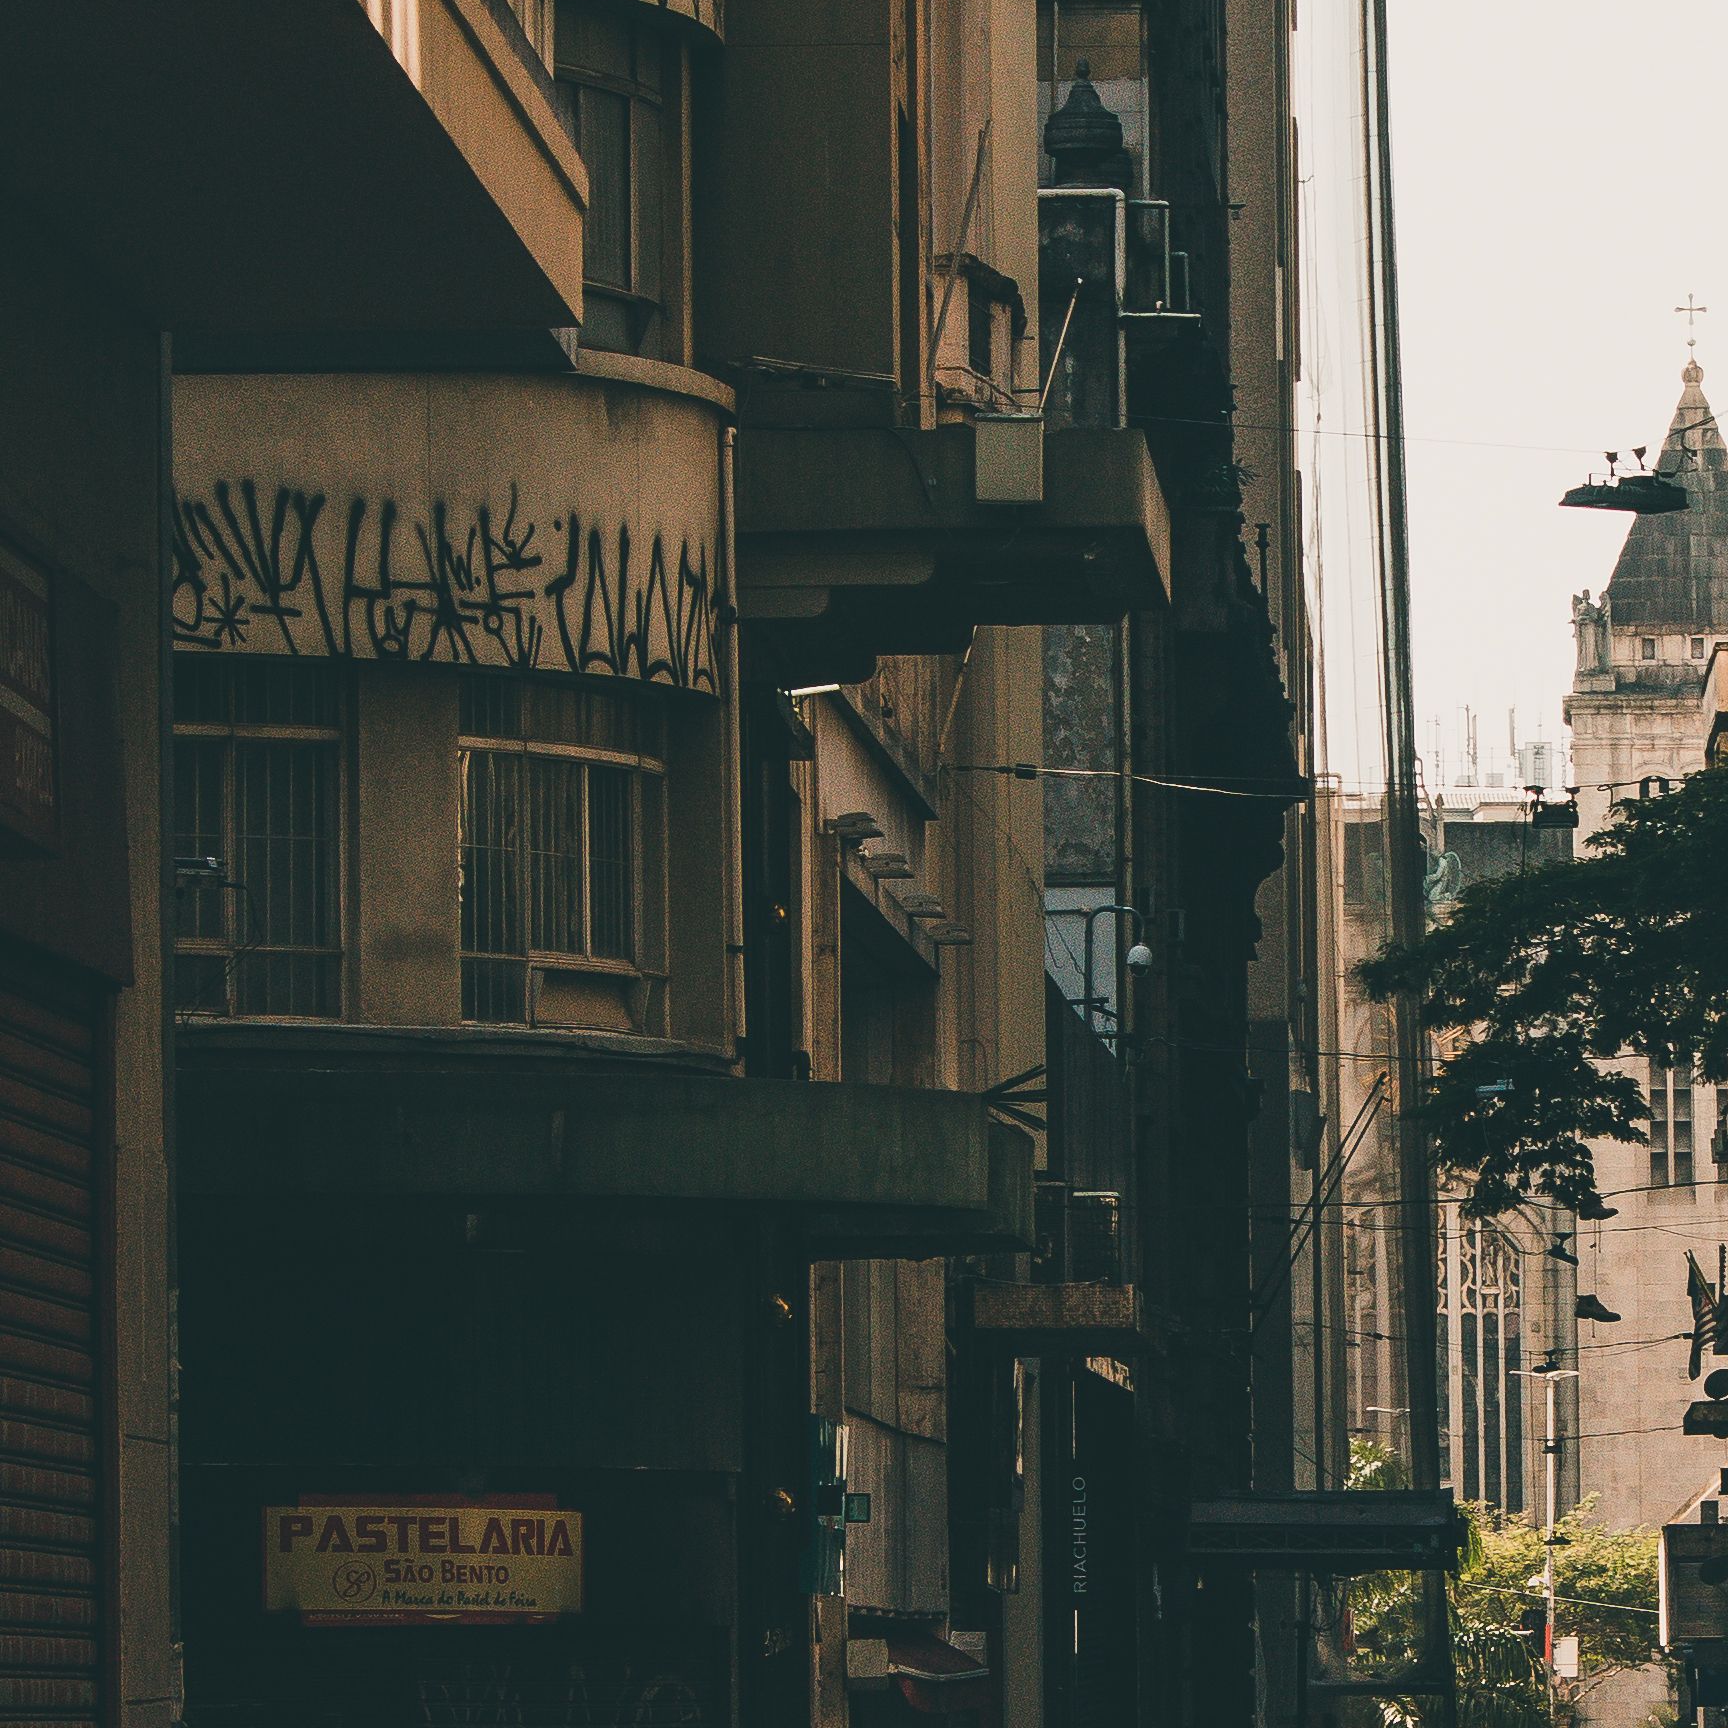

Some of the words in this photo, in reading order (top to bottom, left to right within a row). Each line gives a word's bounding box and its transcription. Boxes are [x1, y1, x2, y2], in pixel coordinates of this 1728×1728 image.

[278, 1514, 573, 1557] PASTELARIA
[1071, 1476, 1088, 1593] RIACHUELO
[442, 1559, 511, 1586] BENTO
